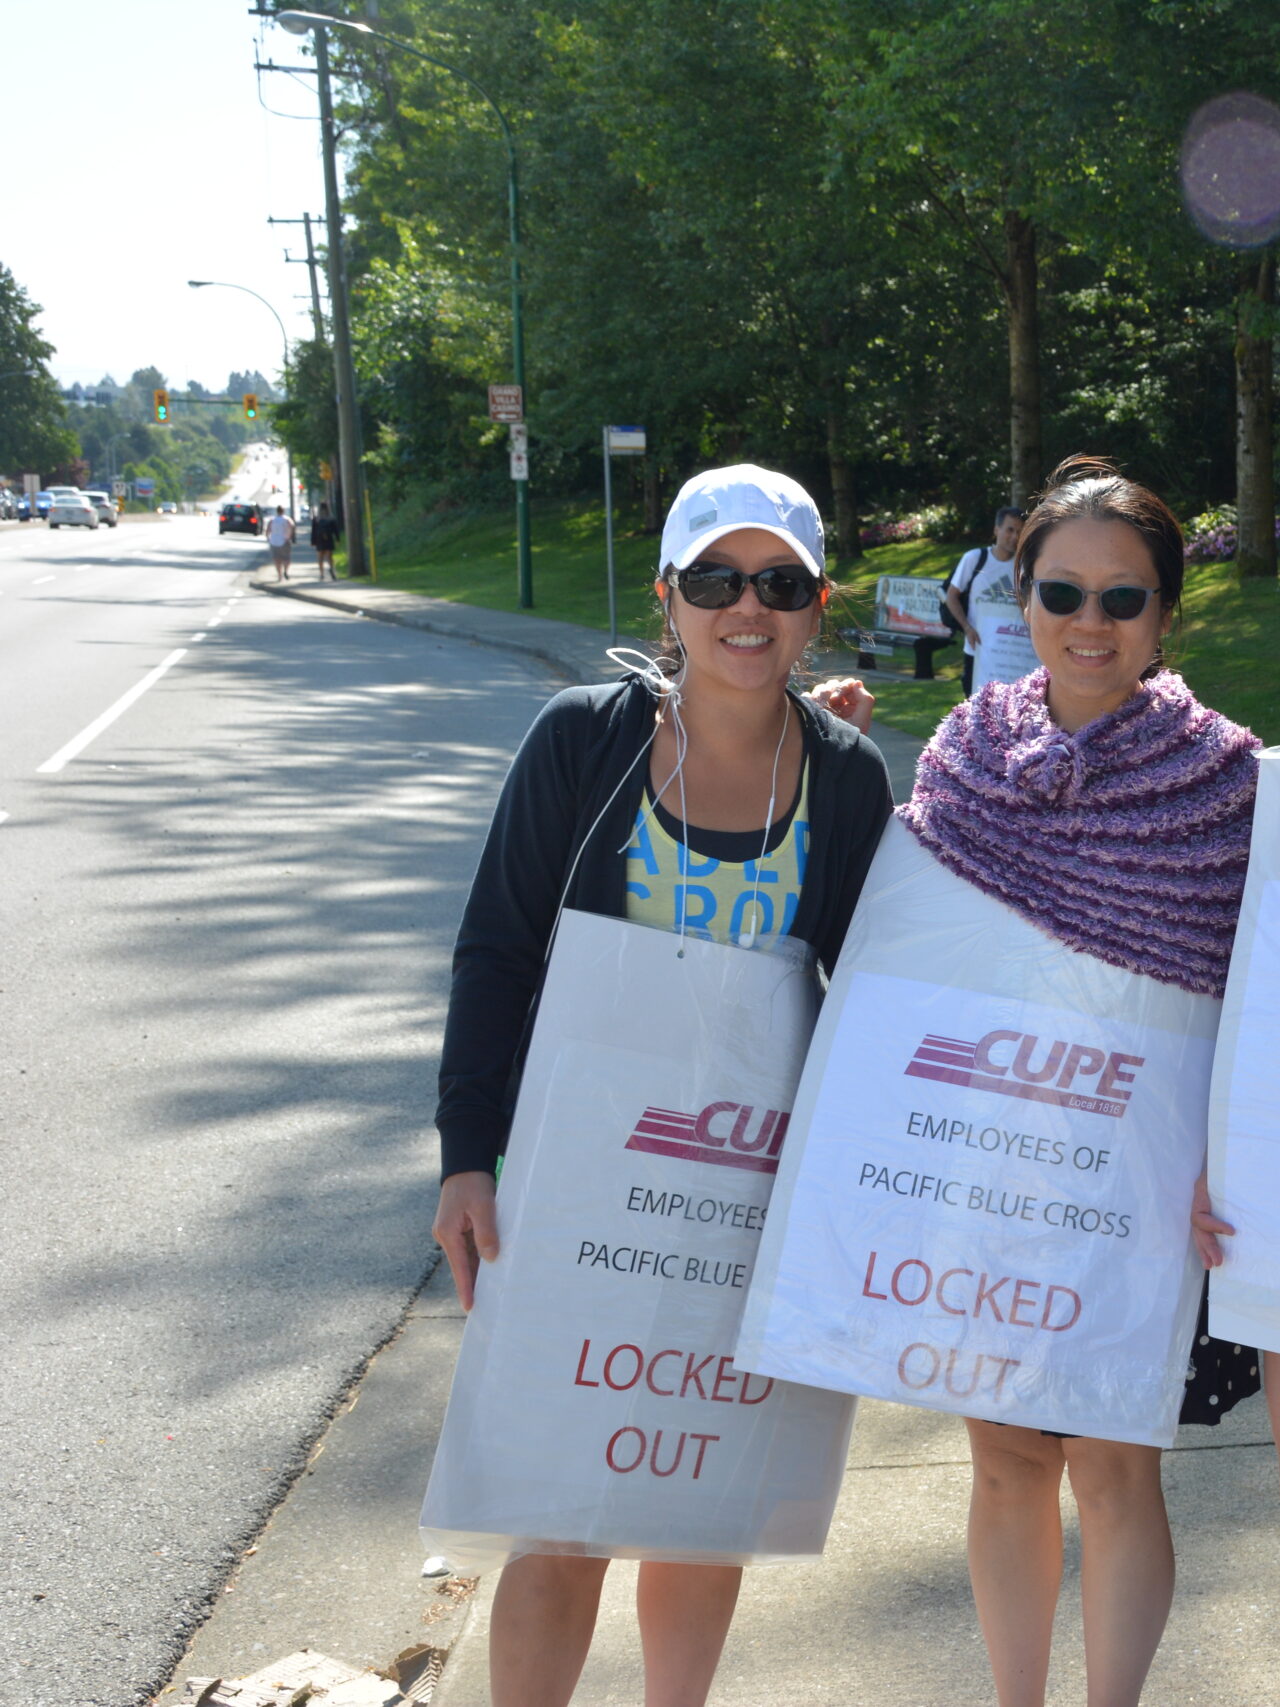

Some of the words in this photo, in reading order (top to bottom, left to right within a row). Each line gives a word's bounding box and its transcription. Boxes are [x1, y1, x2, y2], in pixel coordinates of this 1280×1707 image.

[974, 1029, 1145, 1101] CUPE
[1069, 1096, 1097, 1110] Local
[1098, 1102, 1121, 1114] 1816
[905, 1111, 1067, 1165] EMPLOYEES
[1073, 1146, 1112, 1174] OF
[858, 1163, 962, 1206] PACIFIC
[968, 1187, 1037, 1222] BLUE
[1043, 1202, 1133, 1239] CROSS
[577, 1241, 680, 1279] PACIFIC
[683, 1257, 747, 1288] BLUE
[862, 1251, 1082, 1332] LOCKED
[574, 1338, 774, 1405] LOCKED
[898, 1342, 1021, 1404] OUT
[605, 1426, 720, 1480] OUT
